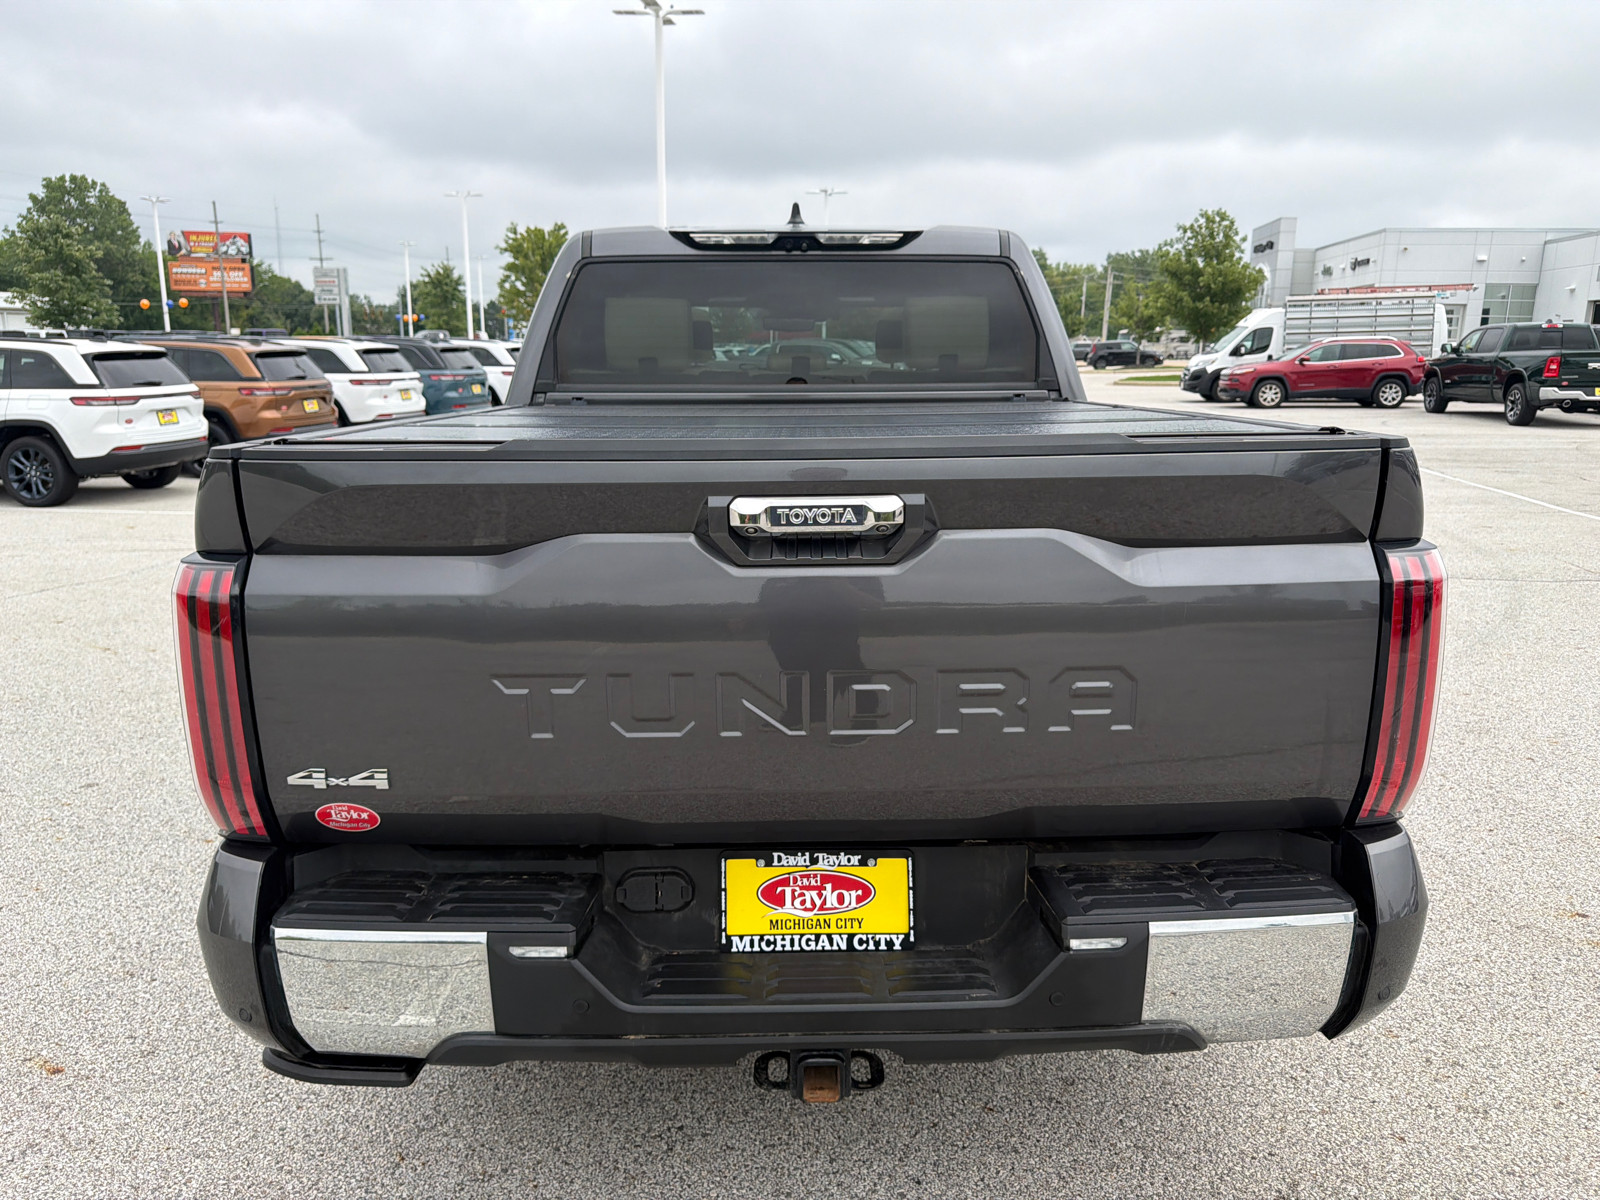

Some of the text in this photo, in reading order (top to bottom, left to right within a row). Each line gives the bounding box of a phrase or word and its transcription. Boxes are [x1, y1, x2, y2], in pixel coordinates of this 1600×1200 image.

[777, 508, 857, 525] TOYOTA
[490, 665, 1138, 739] TUNDRA
[326, 809, 370, 822] Taylor
[772, 852, 862, 869] David Taylor
[789, 874, 821, 887] David
[772, 883, 863, 915] Taylor
[769, 917, 864, 931] MICHIGAN CITY
[730, 934, 905, 953] MICHIGAN CITY
